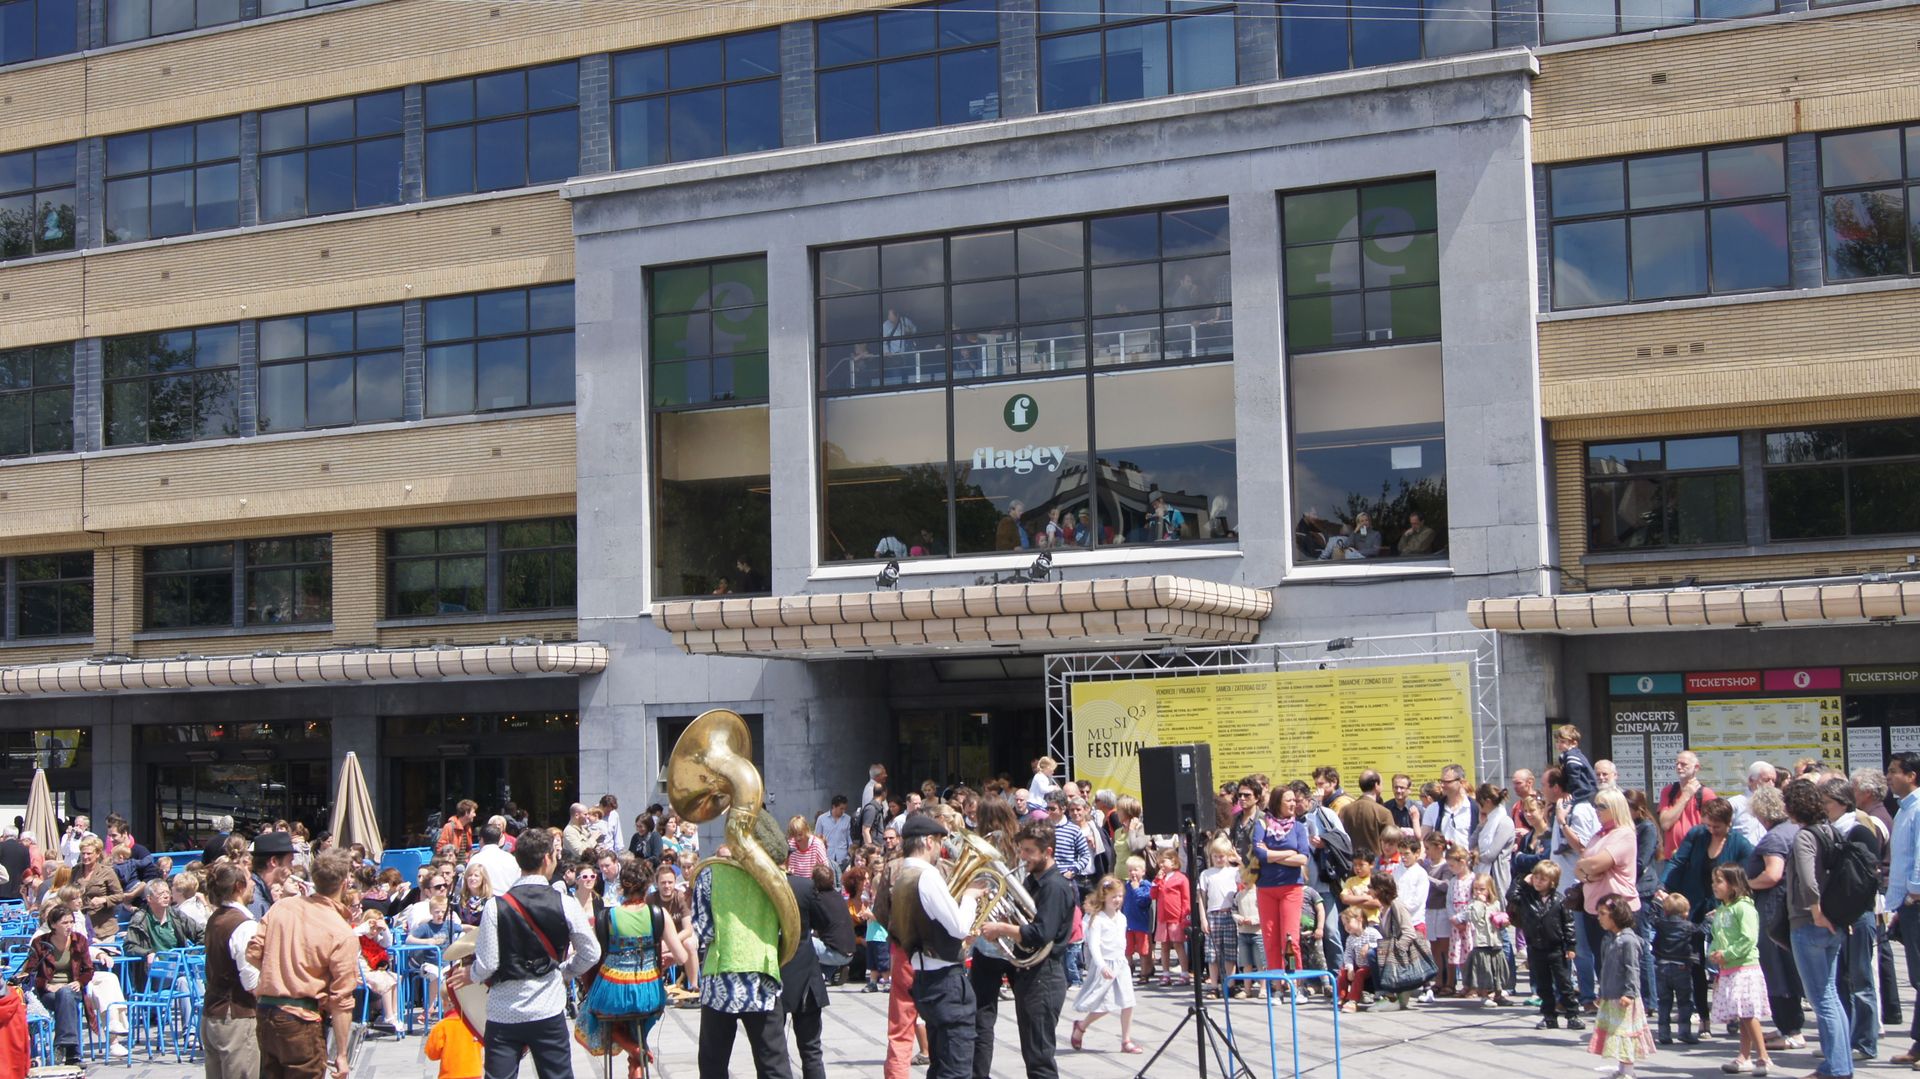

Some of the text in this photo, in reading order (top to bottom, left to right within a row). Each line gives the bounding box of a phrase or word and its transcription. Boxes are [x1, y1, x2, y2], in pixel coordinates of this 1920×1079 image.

[972, 445, 1069, 475] flagey
[1848, 671, 1919, 682] TICKETSHOP
[1689, 677, 1756, 688] TICKETSHOP
[1615, 711, 1675, 722] CONCERTS
[1615, 723, 1679, 733] CINEMA 7/7
